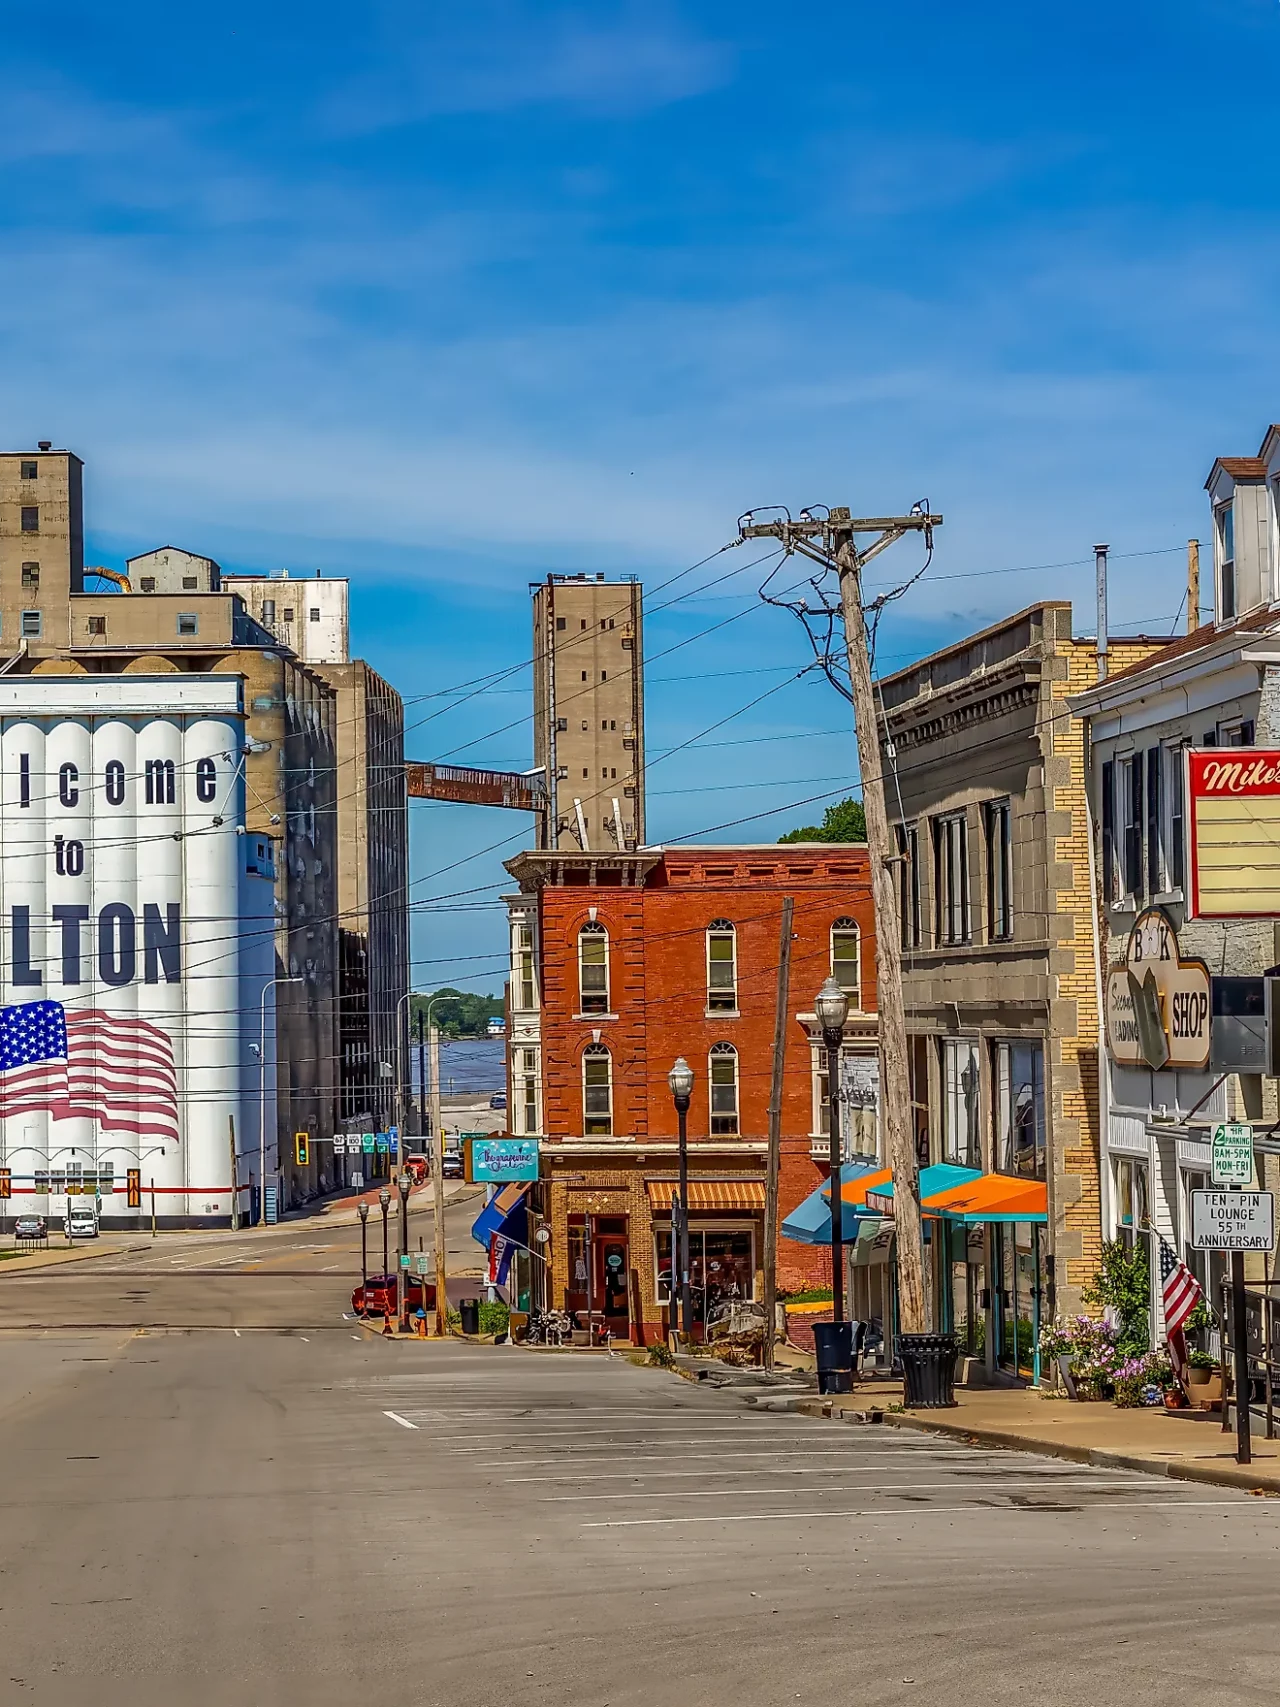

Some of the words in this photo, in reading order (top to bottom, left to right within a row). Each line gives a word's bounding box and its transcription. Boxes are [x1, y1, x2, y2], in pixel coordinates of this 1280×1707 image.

[54, 834, 84, 876] to
[1172, 991, 1208, 1038] SHOP
[1112, 1020, 1140, 1042] EADING
[1224, 1137, 1250, 1146] PARKING
[1214, 1148, 1250, 1159] 8AM-5PM
[1215, 1160, 1249, 1171] MON-FRI
[1204, 1194, 1227, 1206] TEN
[1239, 1195, 1260, 1208] PIN
[1210, 1207, 1256, 1221] LOUNGE
[1218, 1221, 1233, 1234] 55
[1197, 1234, 1269, 1248] ANNIVERSARY
